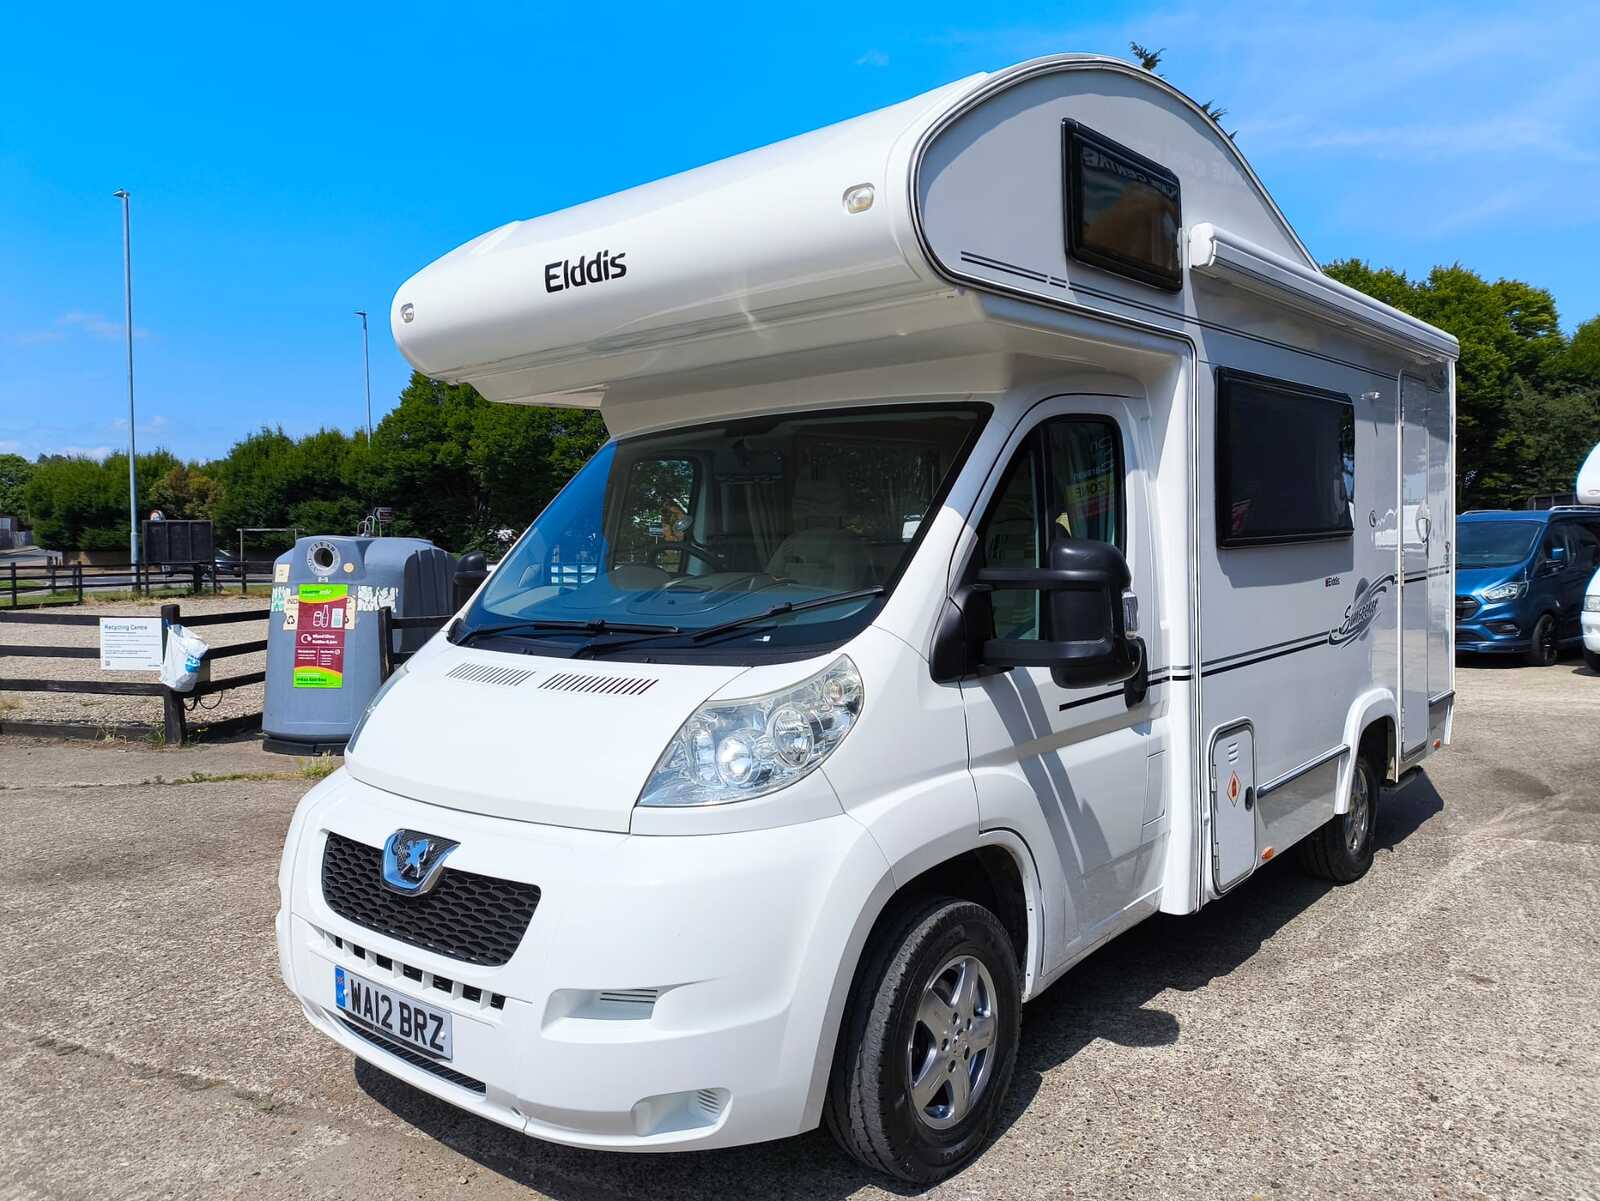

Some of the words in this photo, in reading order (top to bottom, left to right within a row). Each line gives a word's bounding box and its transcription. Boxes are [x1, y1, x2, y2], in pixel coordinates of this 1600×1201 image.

[544, 249, 627, 293] Elddis
[350, 978, 393, 1030] WA12
[398, 1001, 444, 1052] BRZ
